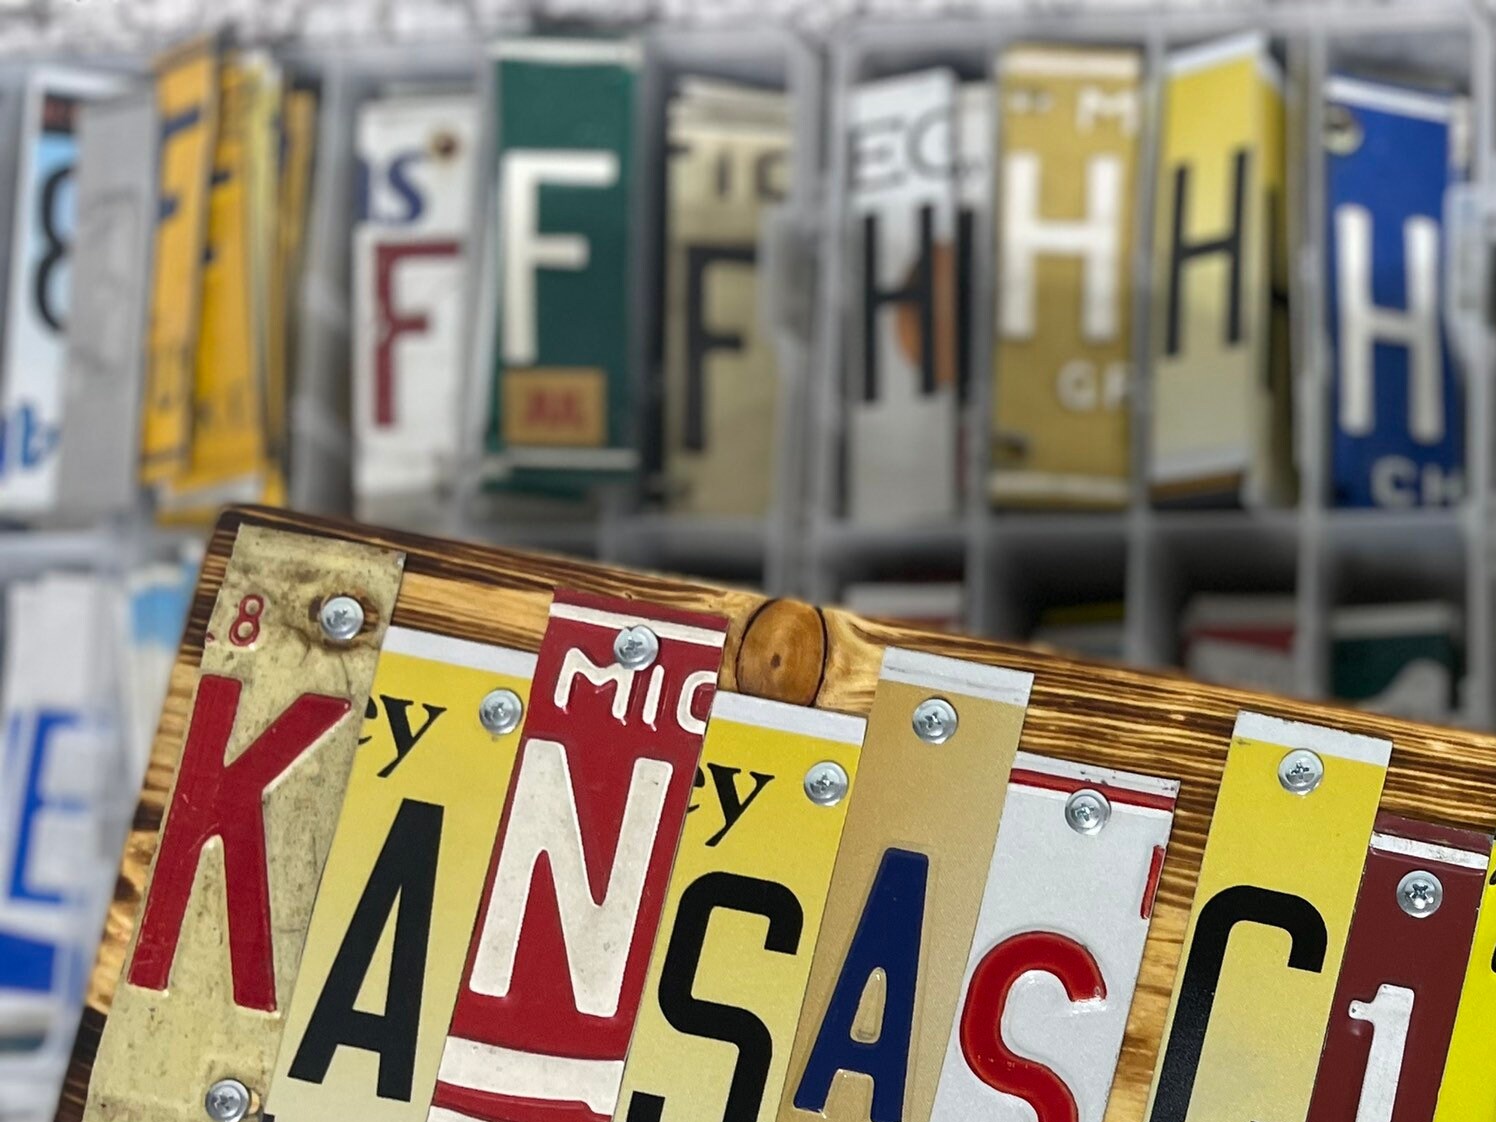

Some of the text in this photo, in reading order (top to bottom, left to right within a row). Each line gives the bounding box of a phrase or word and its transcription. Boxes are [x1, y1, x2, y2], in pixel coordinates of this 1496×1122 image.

[371, 238, 462, 430] F
[503, 148, 619, 368] F
[1001, 152, 1128, 342] H
[1163, 145, 1251, 360] H
[1333, 202, 1446, 446] H
[228, 594, 264, 648] 8
